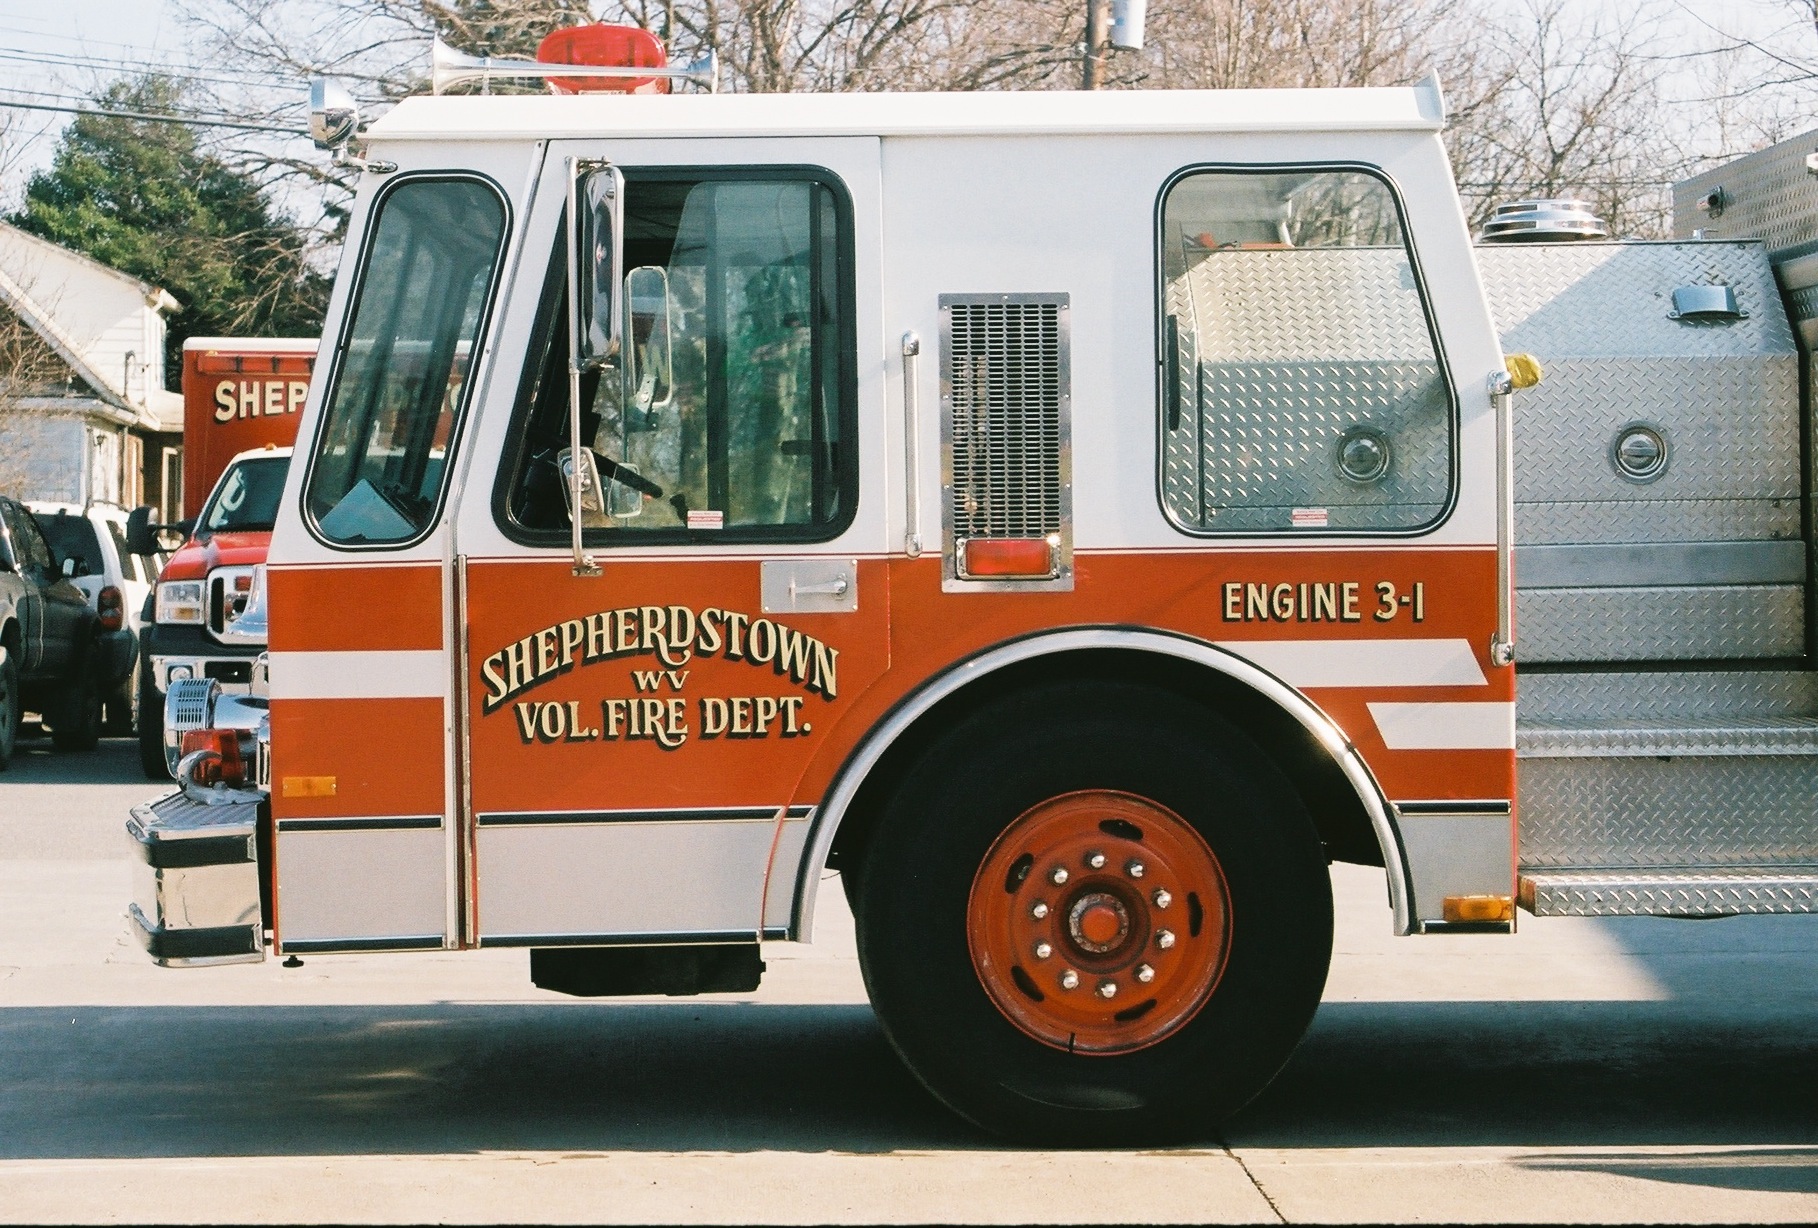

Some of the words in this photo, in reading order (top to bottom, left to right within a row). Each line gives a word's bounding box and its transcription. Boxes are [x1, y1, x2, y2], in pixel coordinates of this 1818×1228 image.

[1222, 581, 1361, 622] ENGINE
[1373, 581, 1424, 622] 3-1
[480, 605, 840, 715] SHEPHERDSTOWN
[632, 669, 690, 692] WV
[514, 700, 599, 743] VOL.
[603, 697, 689, 750] FIRE
[699, 696, 812, 740] DEPT.
